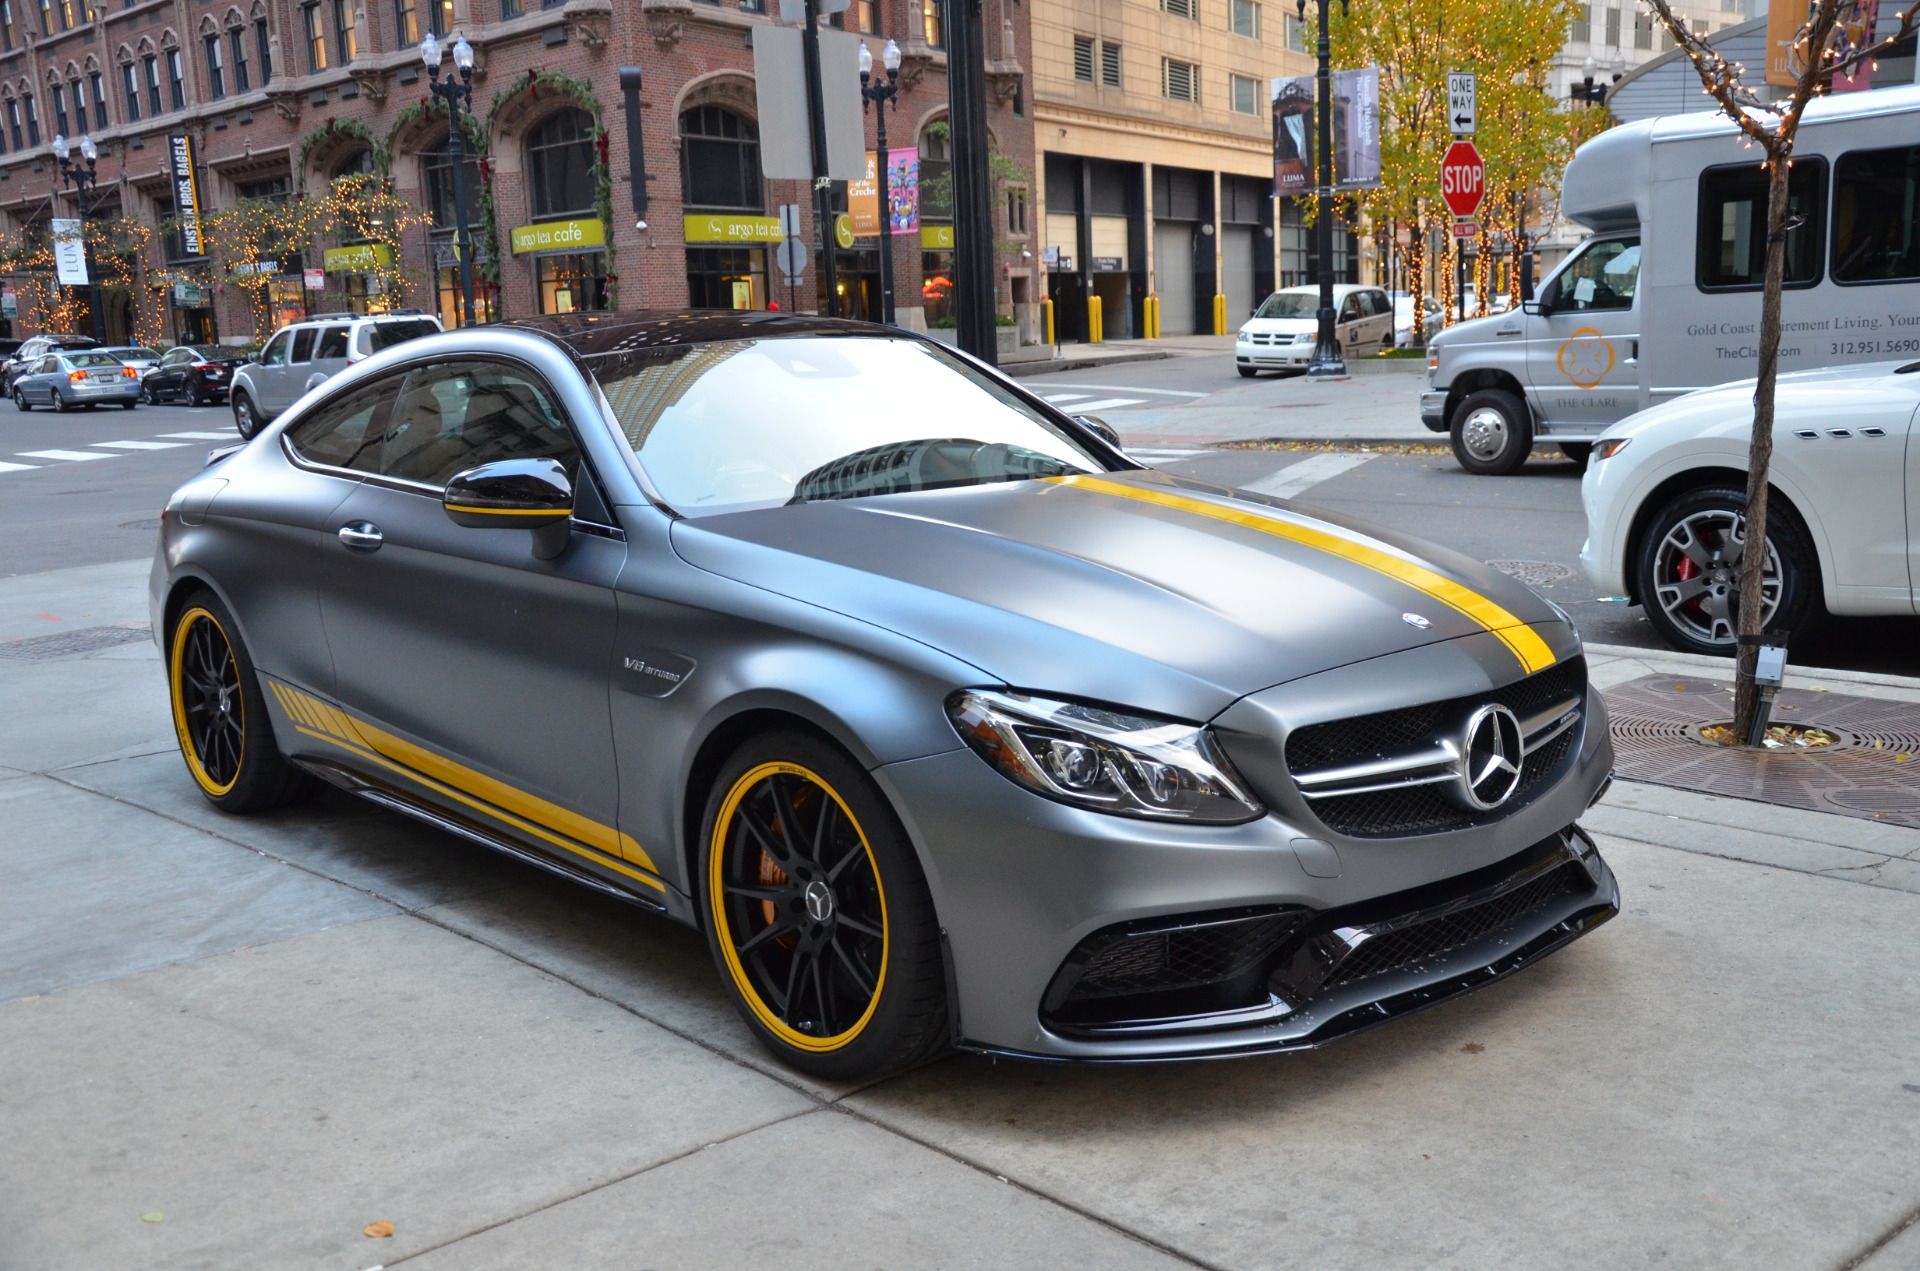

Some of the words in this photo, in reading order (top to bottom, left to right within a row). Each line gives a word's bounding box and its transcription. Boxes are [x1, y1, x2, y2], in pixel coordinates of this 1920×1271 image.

[1451, 78, 1472, 93] ONE
[1451, 95, 1473, 110] WAY
[173, 137, 190, 176] BAGELS
[1444, 165, 1482, 194] STOP
[179, 179, 194, 206] BROS.
[182, 208, 199, 254] EINSTIN
[537, 231, 551, 244] tea
[554, 222, 582, 242] café
[728, 223, 753, 240] argo
[755, 222, 768, 236] tea
[1687, 323, 1717, 337] Gold
[1720, 322, 1755, 335] Coast
[1761, 319, 1829, 336] irement
[1834, 316, 1882, 331] Living.
[1830, 339, 1920, 355] 312.951.5690
[1557, 398, 1578, 409] THE
